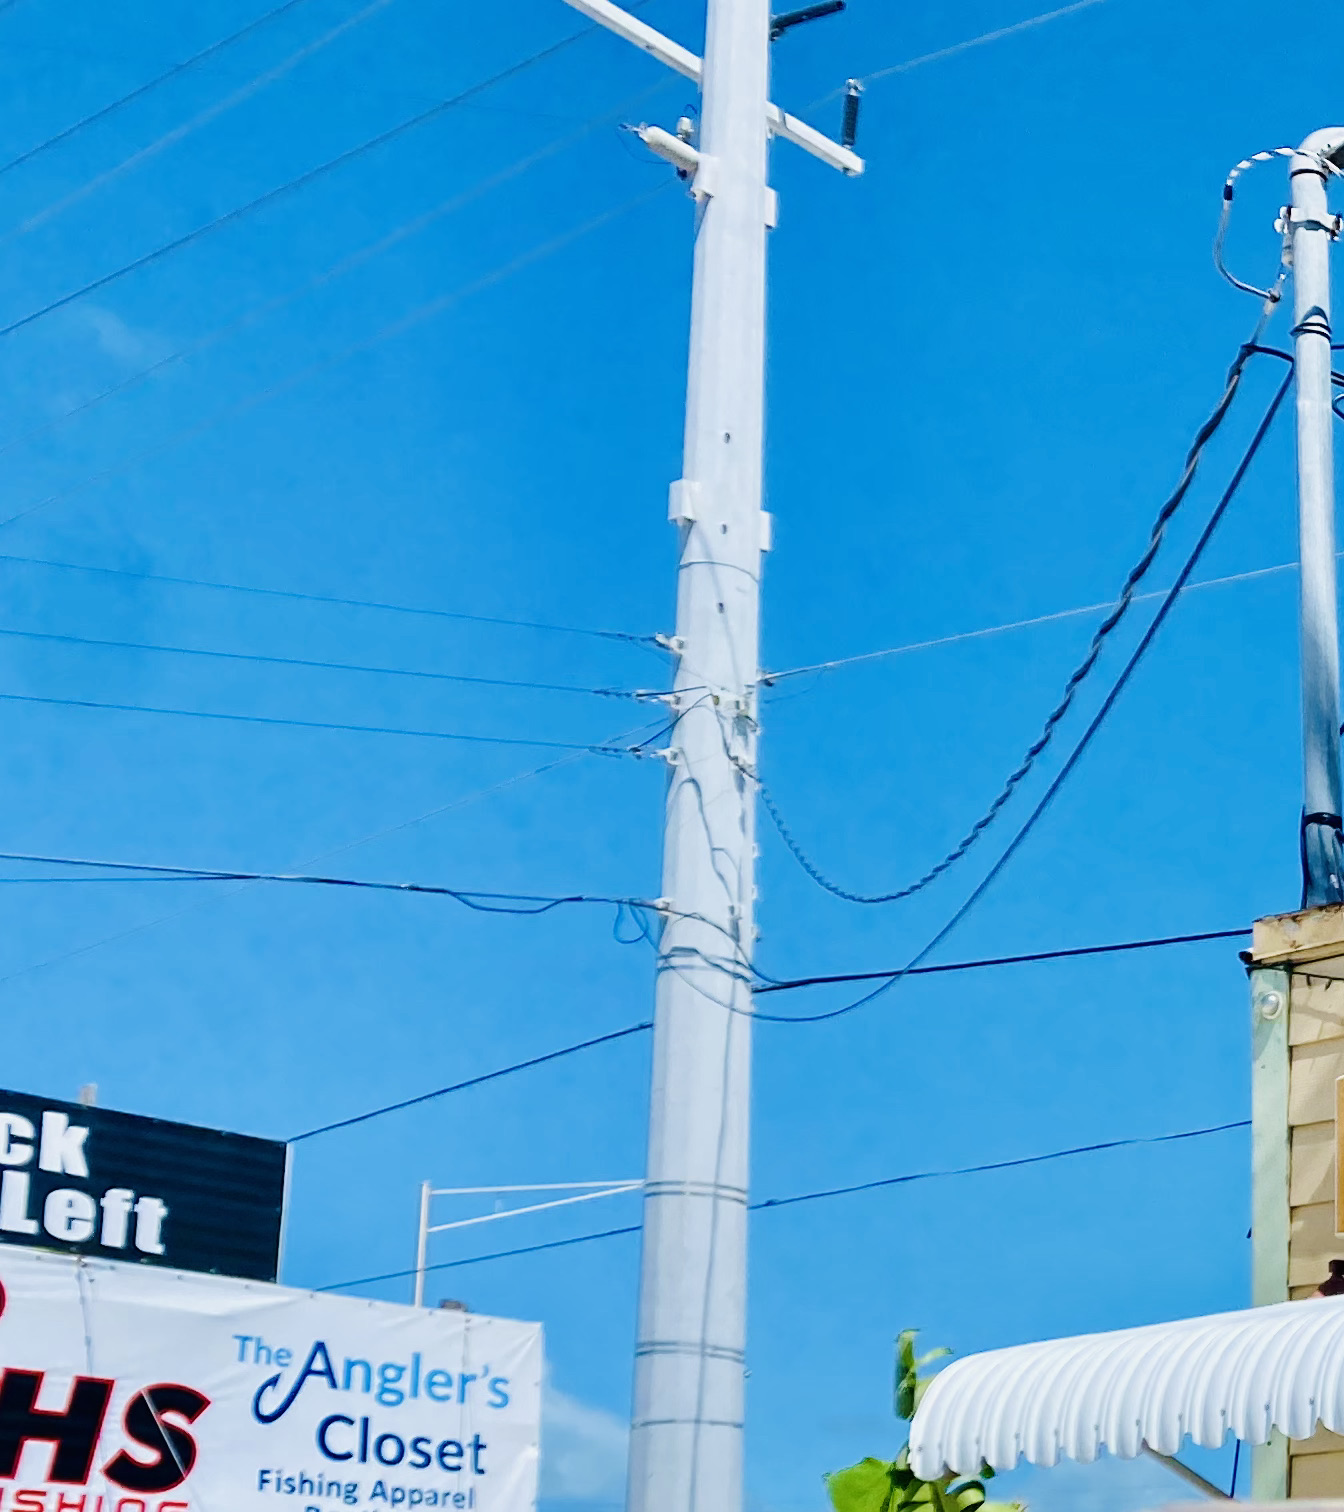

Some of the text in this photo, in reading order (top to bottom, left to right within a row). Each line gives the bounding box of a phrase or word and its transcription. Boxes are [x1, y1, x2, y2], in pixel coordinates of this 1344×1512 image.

[1, 1171, 168, 1256] Left
[232, 1333, 293, 1368] The
[252, 1340, 510, 1425] Angler's
[315, 1413, 487, 1476] Closet
[257, 1468, 475, 1510] Fishing Apparel
